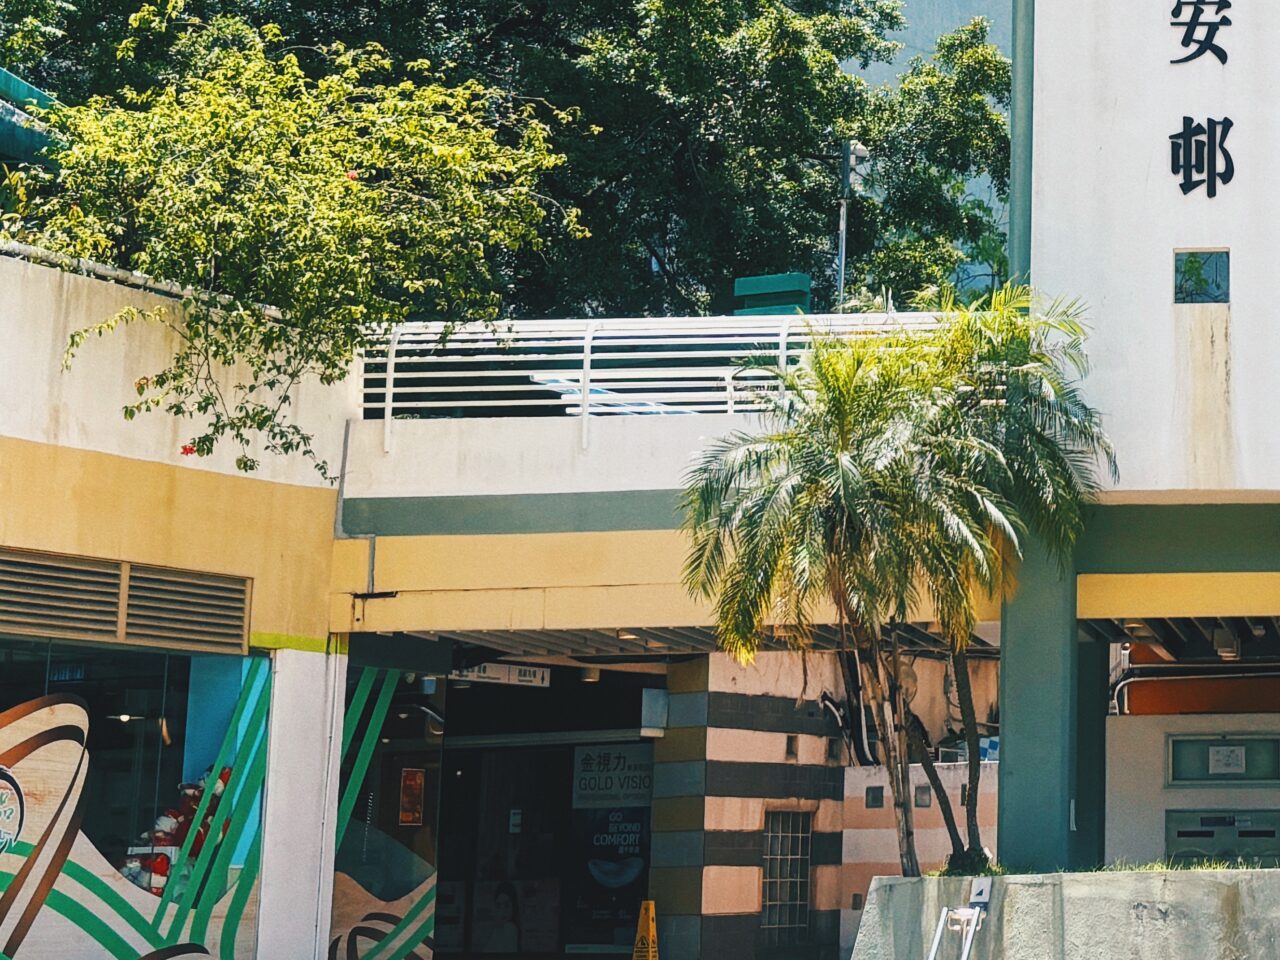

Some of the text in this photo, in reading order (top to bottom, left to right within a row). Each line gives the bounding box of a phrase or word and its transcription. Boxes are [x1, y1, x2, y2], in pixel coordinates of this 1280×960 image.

[580, 751, 627, 773] 金視力
[578, 776, 614, 791] GOLD
[593, 833, 641, 846] COMFORT
